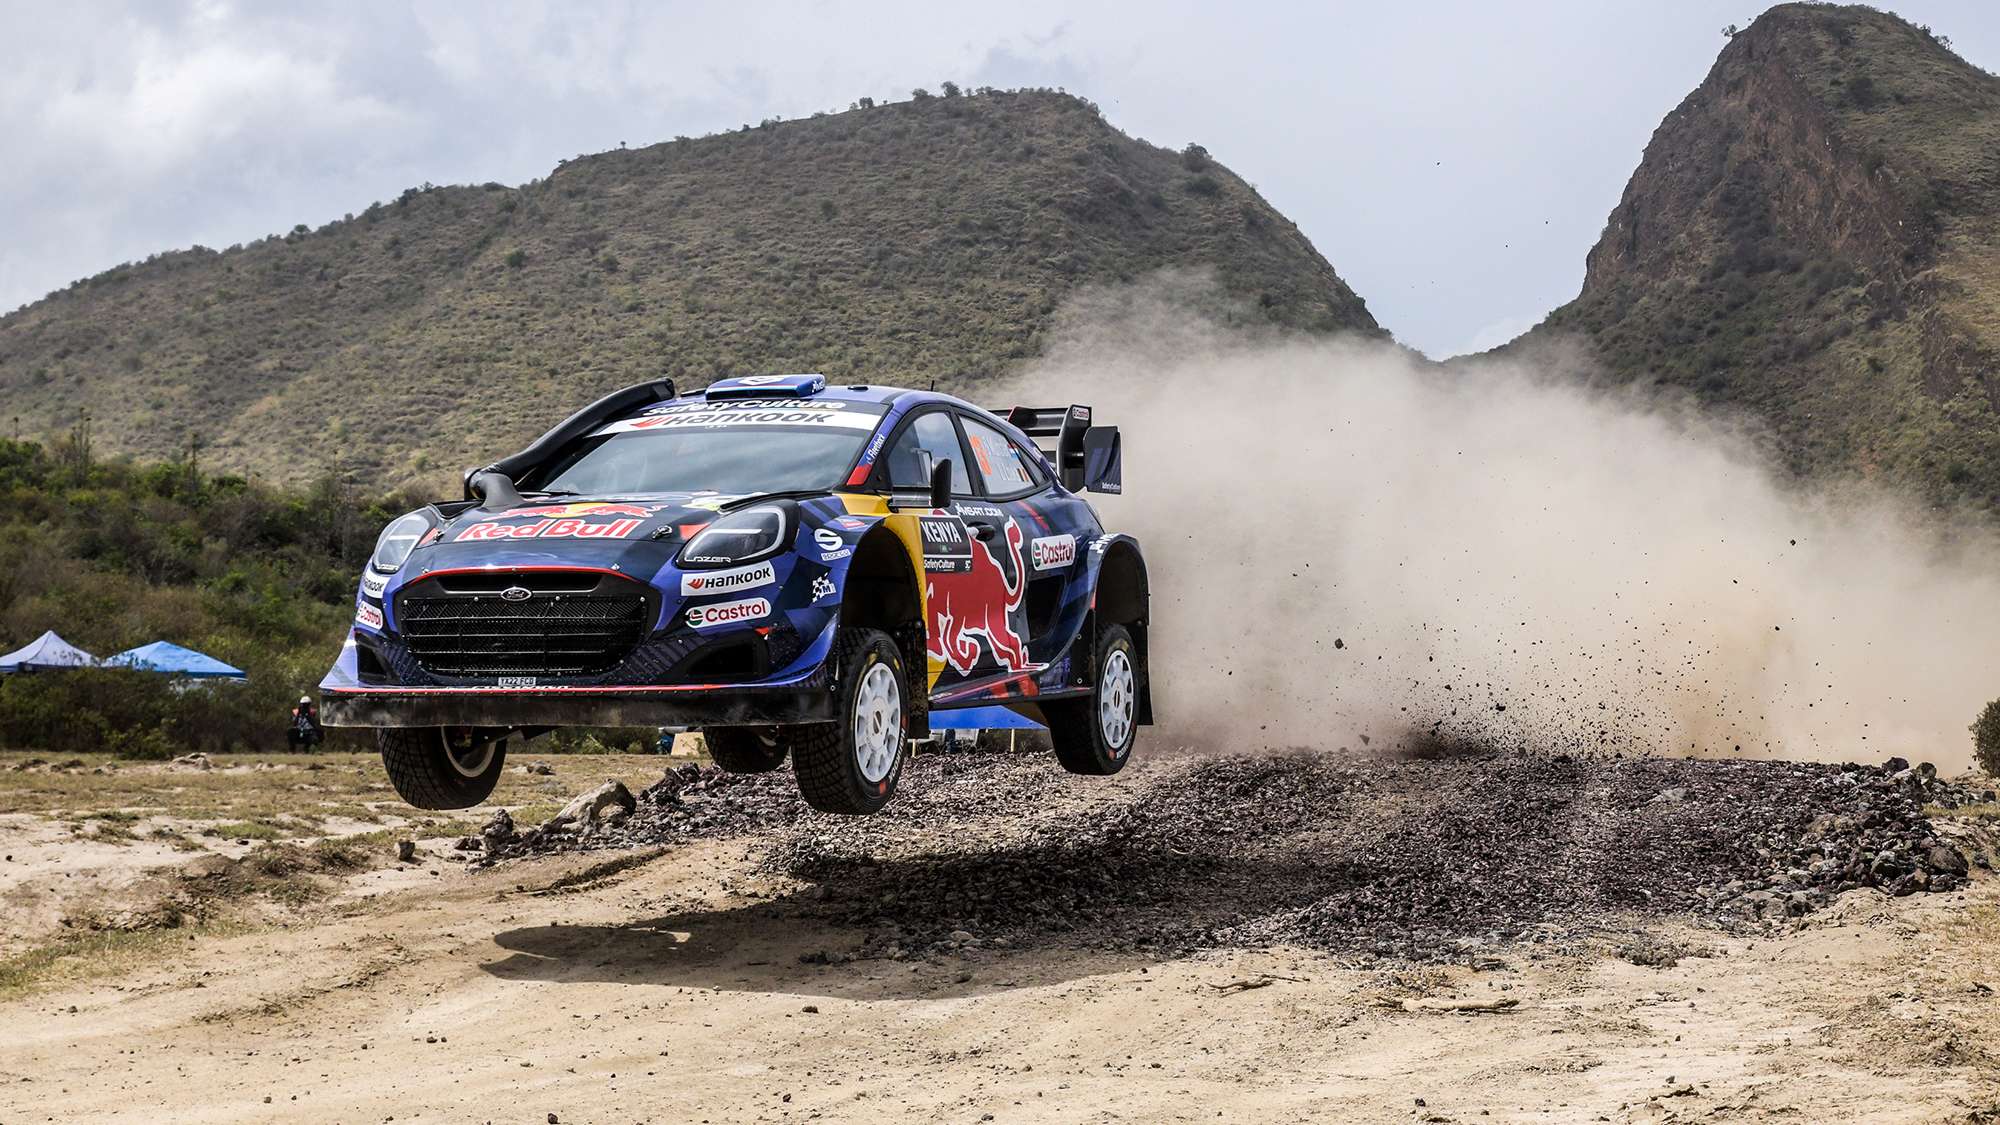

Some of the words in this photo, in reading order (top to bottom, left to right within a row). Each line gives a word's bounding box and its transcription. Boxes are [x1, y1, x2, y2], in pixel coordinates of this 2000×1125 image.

[642, 399, 846, 416] SafetyCulture
[453, 519, 547, 543] Red
[545, 519, 645, 539] Bull
[920, 521, 962, 543] KENYA
[1041, 542, 1073, 565] Castrol
[923, 559, 955, 571] SafetyCulture
[705, 601, 766, 623] Castrol
